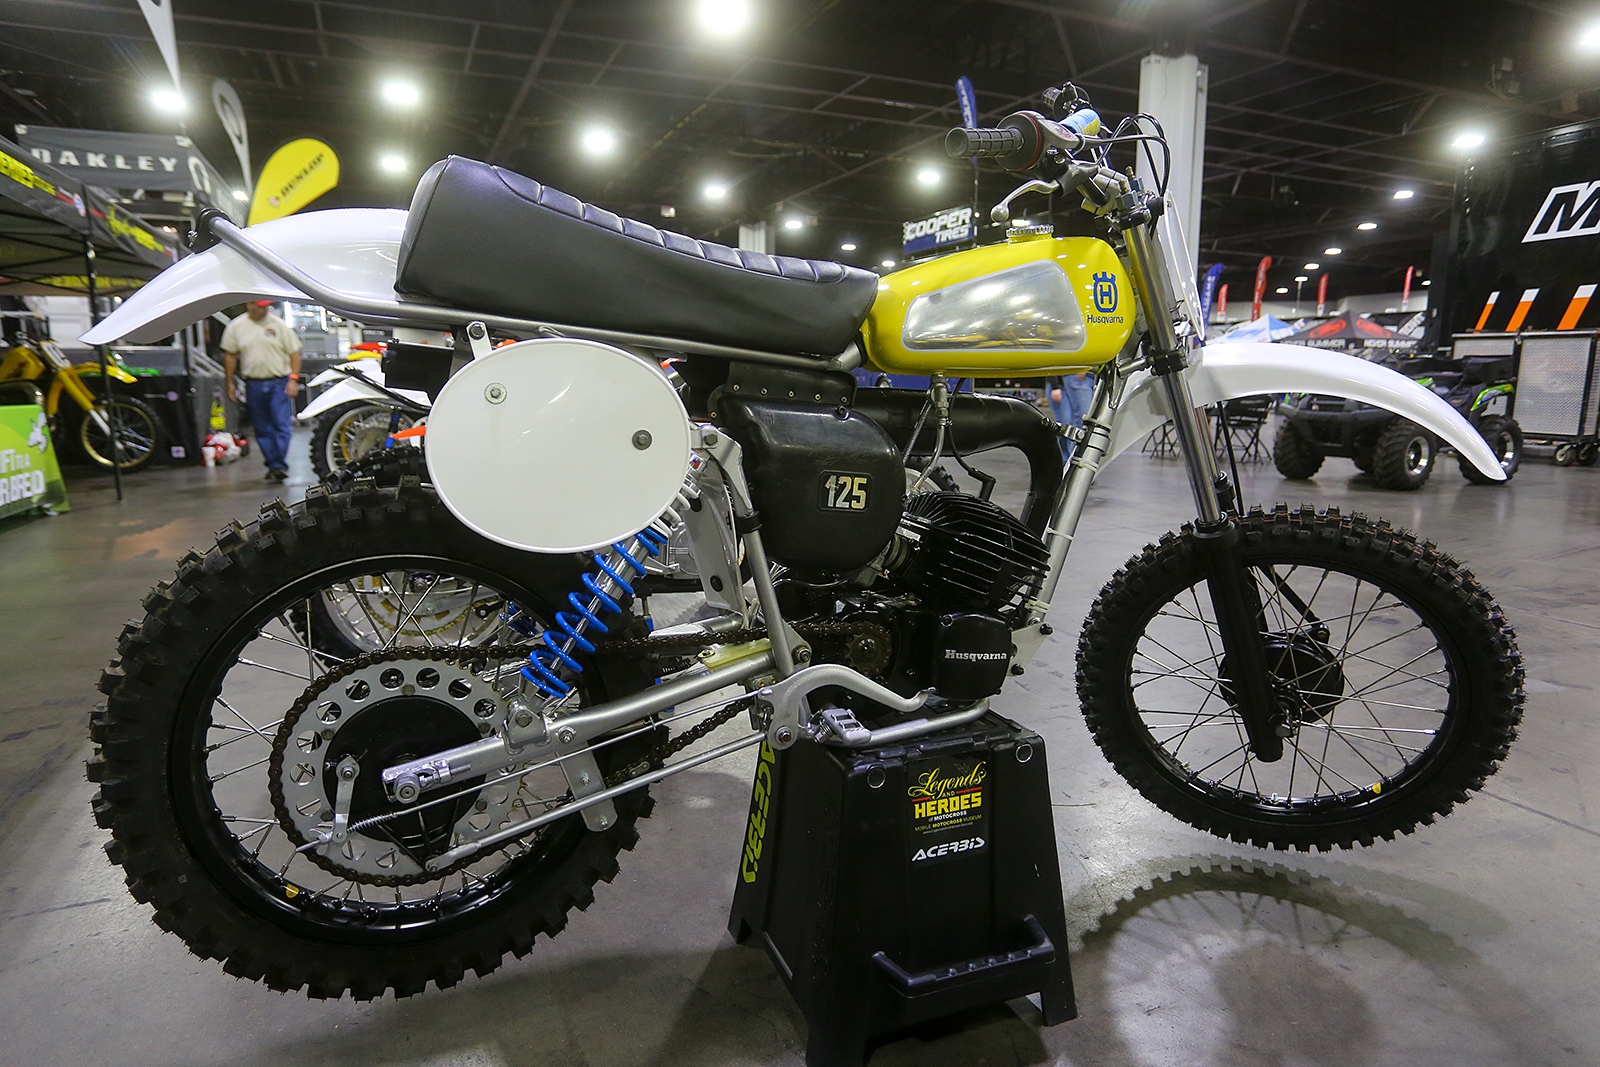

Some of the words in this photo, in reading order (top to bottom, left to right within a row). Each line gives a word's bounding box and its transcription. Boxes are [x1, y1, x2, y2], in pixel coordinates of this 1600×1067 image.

[31, 147, 178, 172] OAKLEY
[280, 152, 324, 198] DUNLOP
[903, 207, 972, 241] COOPER
[935, 224, 970, 244] TIRES
[1087, 314, 1124, 324] Husqvarna
[825, 475, 867, 509] 125
[945, 649, 1007, 662] Husqvarna
[907, 761, 987, 799] Legends
[914, 792, 982, 819] HEROES
[942, 790, 955, 798] AND
[742, 740, 776, 883] ACERBIS
[932, 818, 962, 828] MOTOCROSS
[934, 810, 967, 821] MOTOCROSS
[911, 837, 986, 862] ACERBIS
